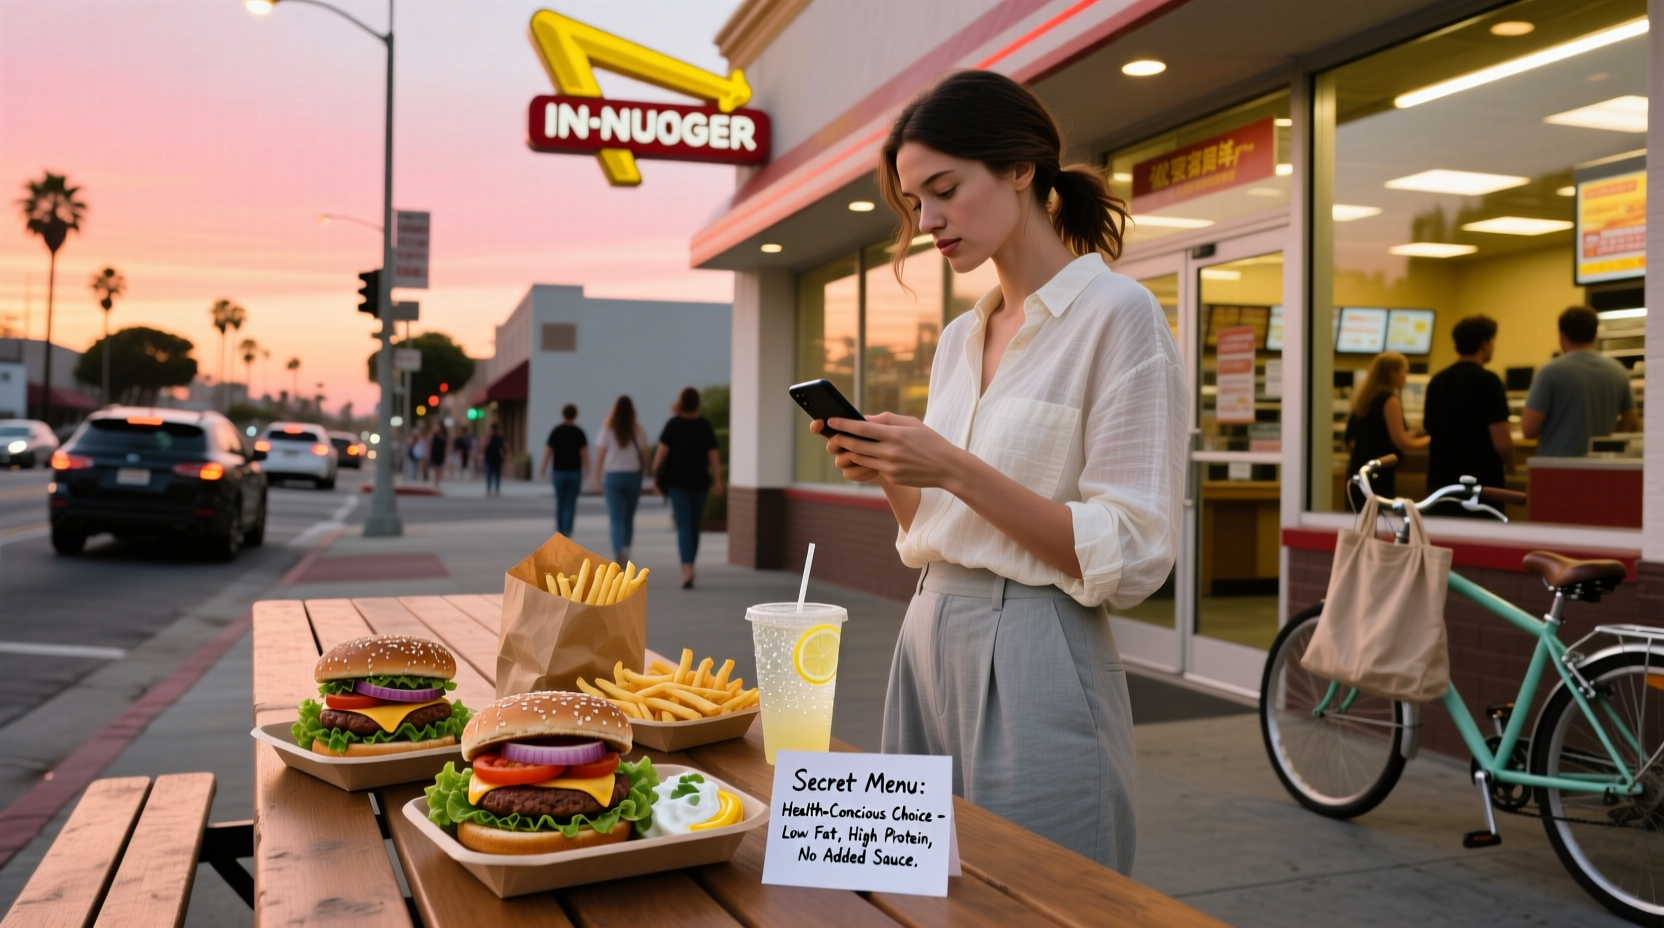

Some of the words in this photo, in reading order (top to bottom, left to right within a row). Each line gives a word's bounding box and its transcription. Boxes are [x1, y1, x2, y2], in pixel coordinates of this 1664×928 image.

[544, 102, 757, 151] IN-NUOGER
[792, 768, 858, 793] Secret
[864, 772, 926, 795] Menu:
[781, 801, 887, 820] Health-Concious
[891, 805, 933, 823] Choice
[781, 824, 809, 840] Low
[814, 825, 842, 844] Fat,
[848, 825, 878, 848] High
[884, 826, 933, 850] Protein,
[797, 845, 817, 862] No
[822, 846, 867, 865] Added
[872, 848, 918, 868] Sauce.
